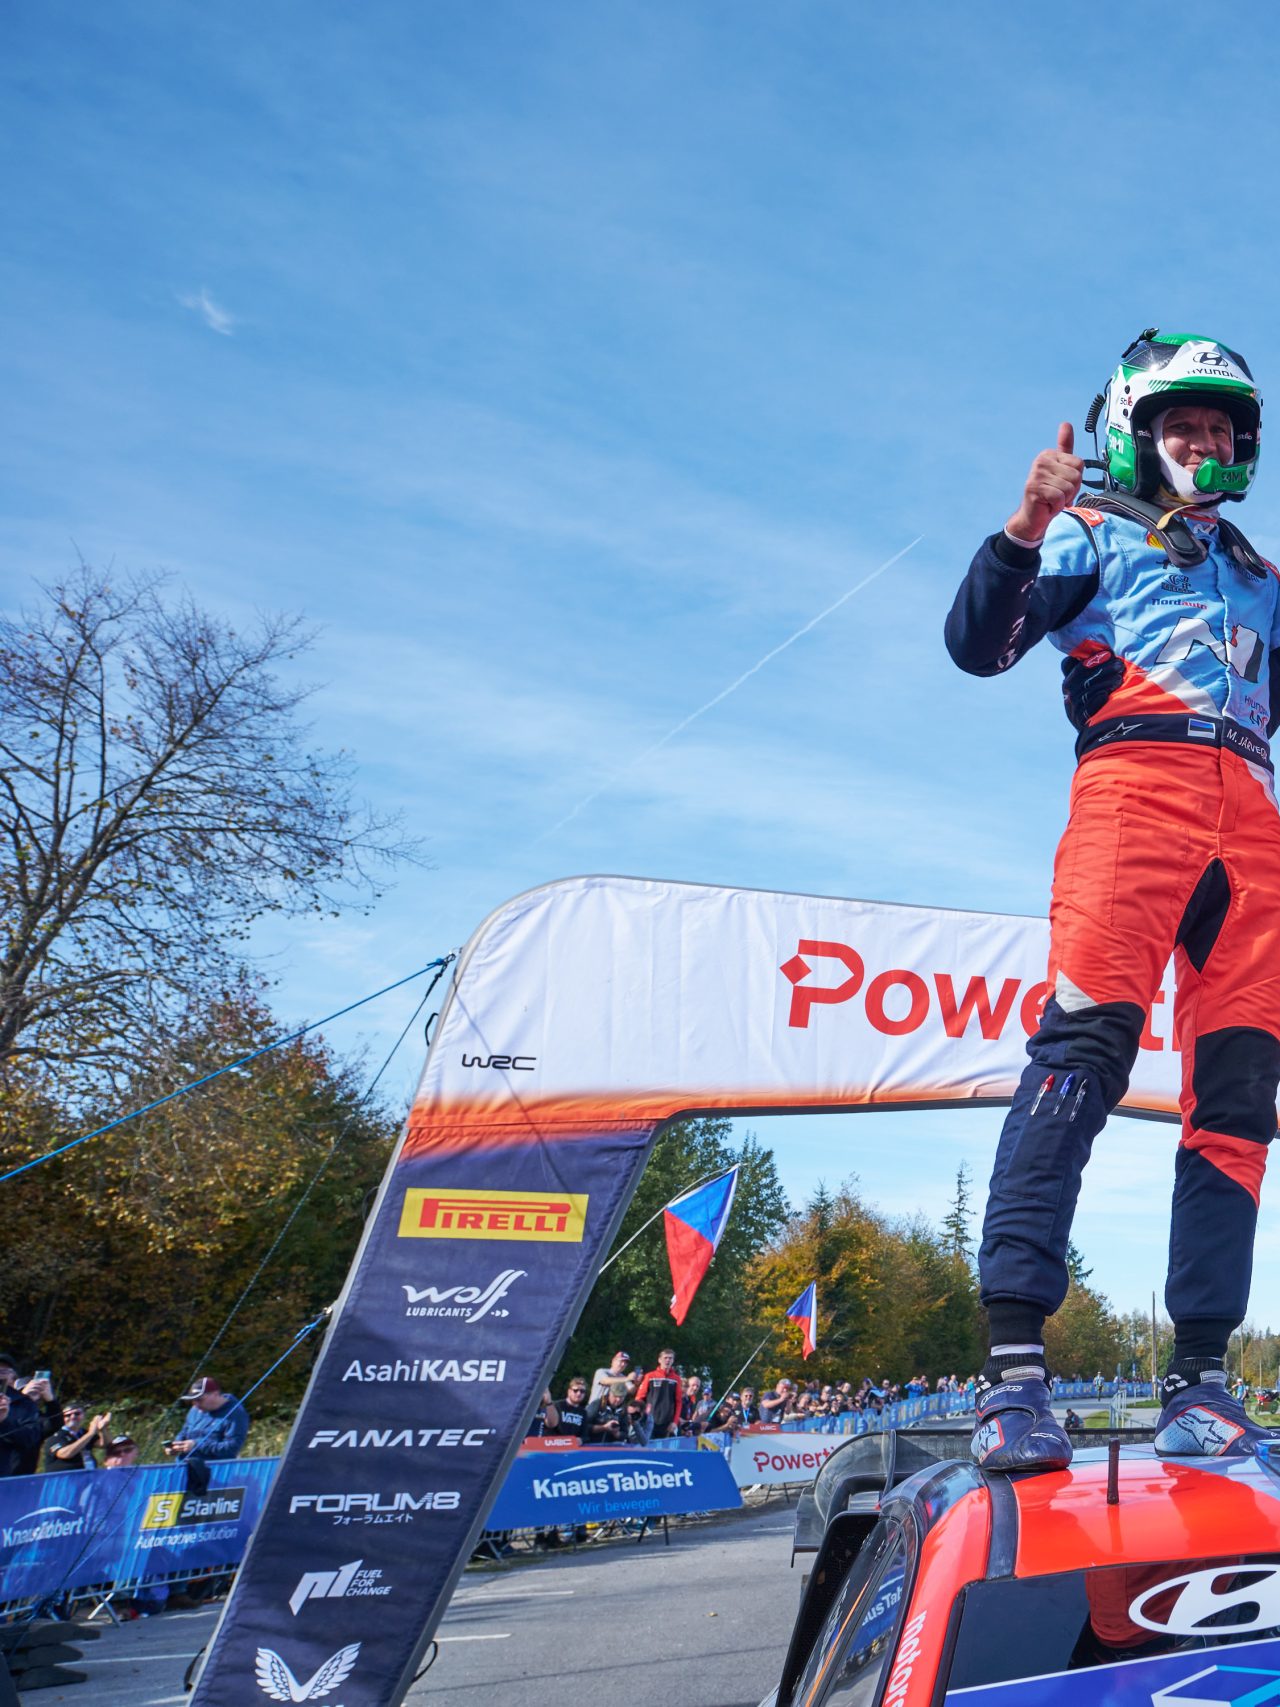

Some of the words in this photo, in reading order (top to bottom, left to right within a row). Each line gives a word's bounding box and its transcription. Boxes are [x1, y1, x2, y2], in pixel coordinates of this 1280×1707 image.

[461, 1053, 537, 1071] WRC
[419, 1198, 572, 1233] PIRELLI
[406, 1307, 472, 1318] LUBRICANTS
[308, 1428, 488, 1448] FANATEC
[180, 1496, 240, 1519] Starline
[288, 1491, 461, 1514] FORUM8
[604, 1497, 661, 1513] bewegen
[332, 1513, 414, 1526] フォーラムエイト
[354, 1569, 383, 1579] FUEL
[350, 1578, 375, 1588] FOR
[345, 1586, 393, 1597] CHANGE
